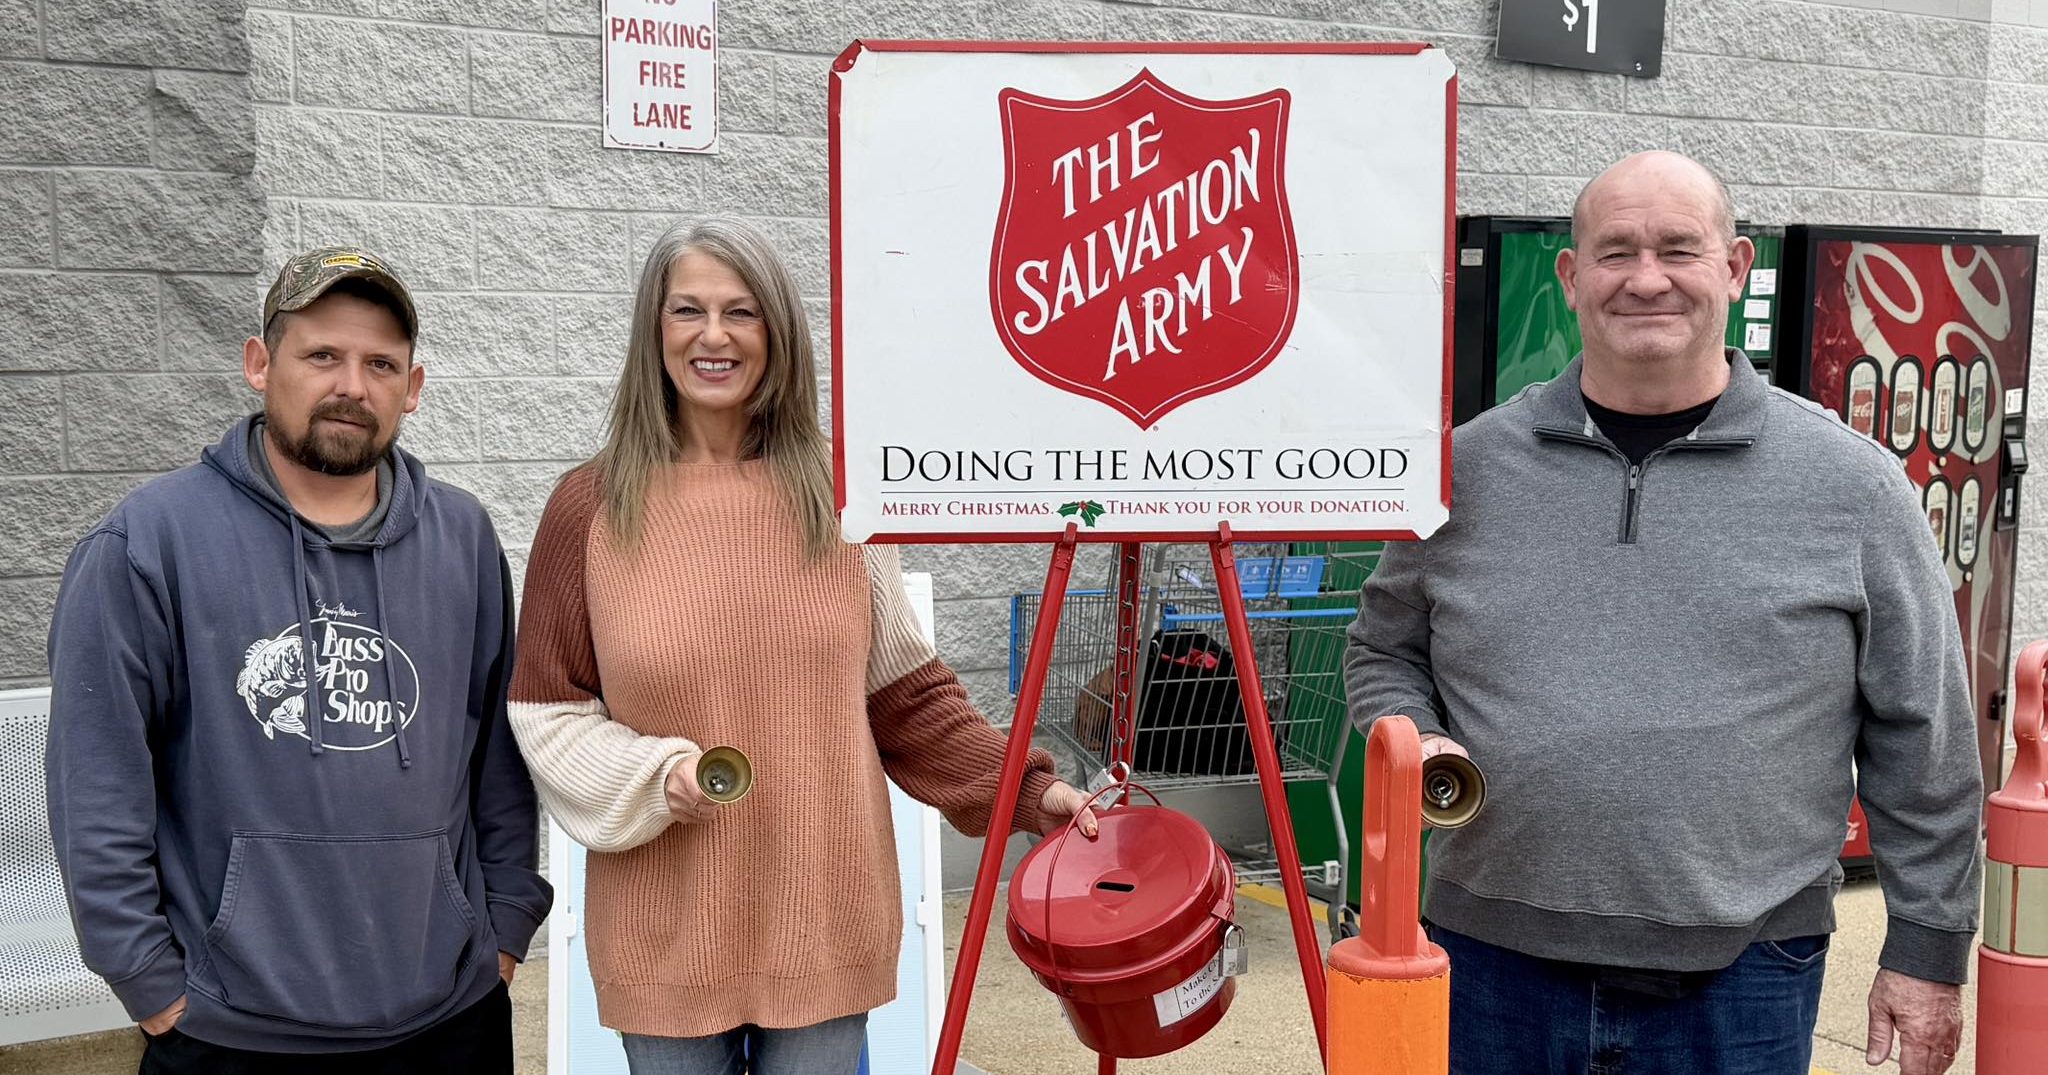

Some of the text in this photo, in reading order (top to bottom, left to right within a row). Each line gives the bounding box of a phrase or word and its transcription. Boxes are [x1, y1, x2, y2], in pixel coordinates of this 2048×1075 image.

[612, 17, 711, 50] PARKING
[640, 60, 686, 89] FIRE
[633, 102, 692, 130] LANE
[1052, 111, 1164, 220] THE
[1014, 127, 1261, 335] SALVATION
[1102, 226, 1254, 382] ARMY
[880, 446, 1033, 482] DOING
[1045, 450, 1128, 481] THE
[1142, 449, 1263, 480] MOST
[881, 501, 941, 516] MERRY
[1107, 499, 1169, 515] THANK
[1176, 501, 1211, 514] YOU
[1217, 501, 1252, 514] FOR
[1256, 500, 1304, 514] YOUR
[1310, 499, 1410, 514] DONATION.
[321, 622, 384, 662] Bass
[324, 657, 368, 693] Pro
[1183, 972, 1206, 994] Make
[1184, 985, 1212, 1009] To the
